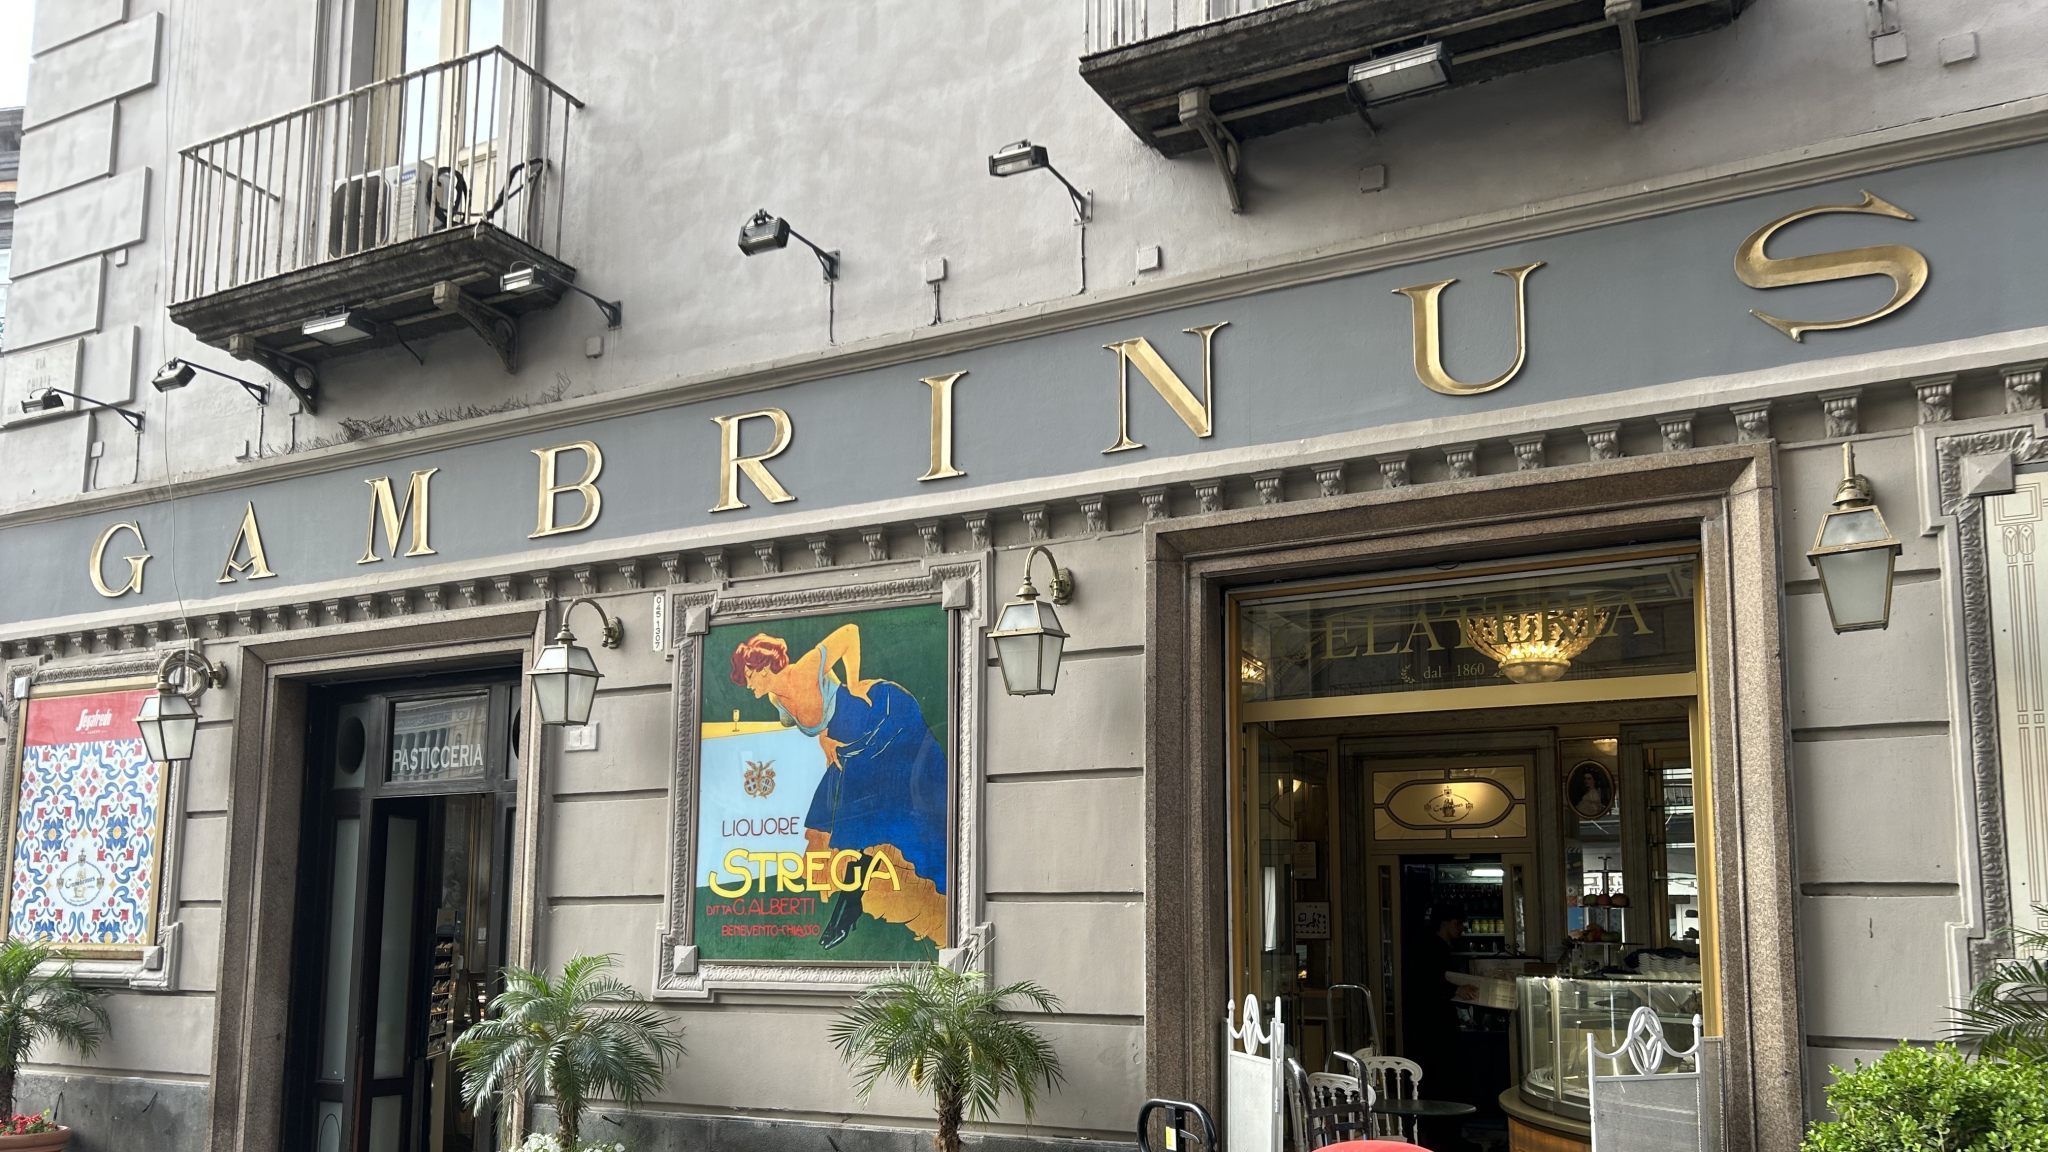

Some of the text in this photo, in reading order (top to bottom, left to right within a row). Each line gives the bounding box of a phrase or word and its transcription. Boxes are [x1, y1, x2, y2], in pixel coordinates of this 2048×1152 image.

[89, 190, 1931, 599] GAMBRINUS
[1423, 663, 1485, 679] dal 1860
[392, 743, 484, 771] PASTICCERIA
[722, 817, 800, 837] LIQUORE
[708, 848, 901, 898] STREGA
[706, 904, 732, 915] DITTA
